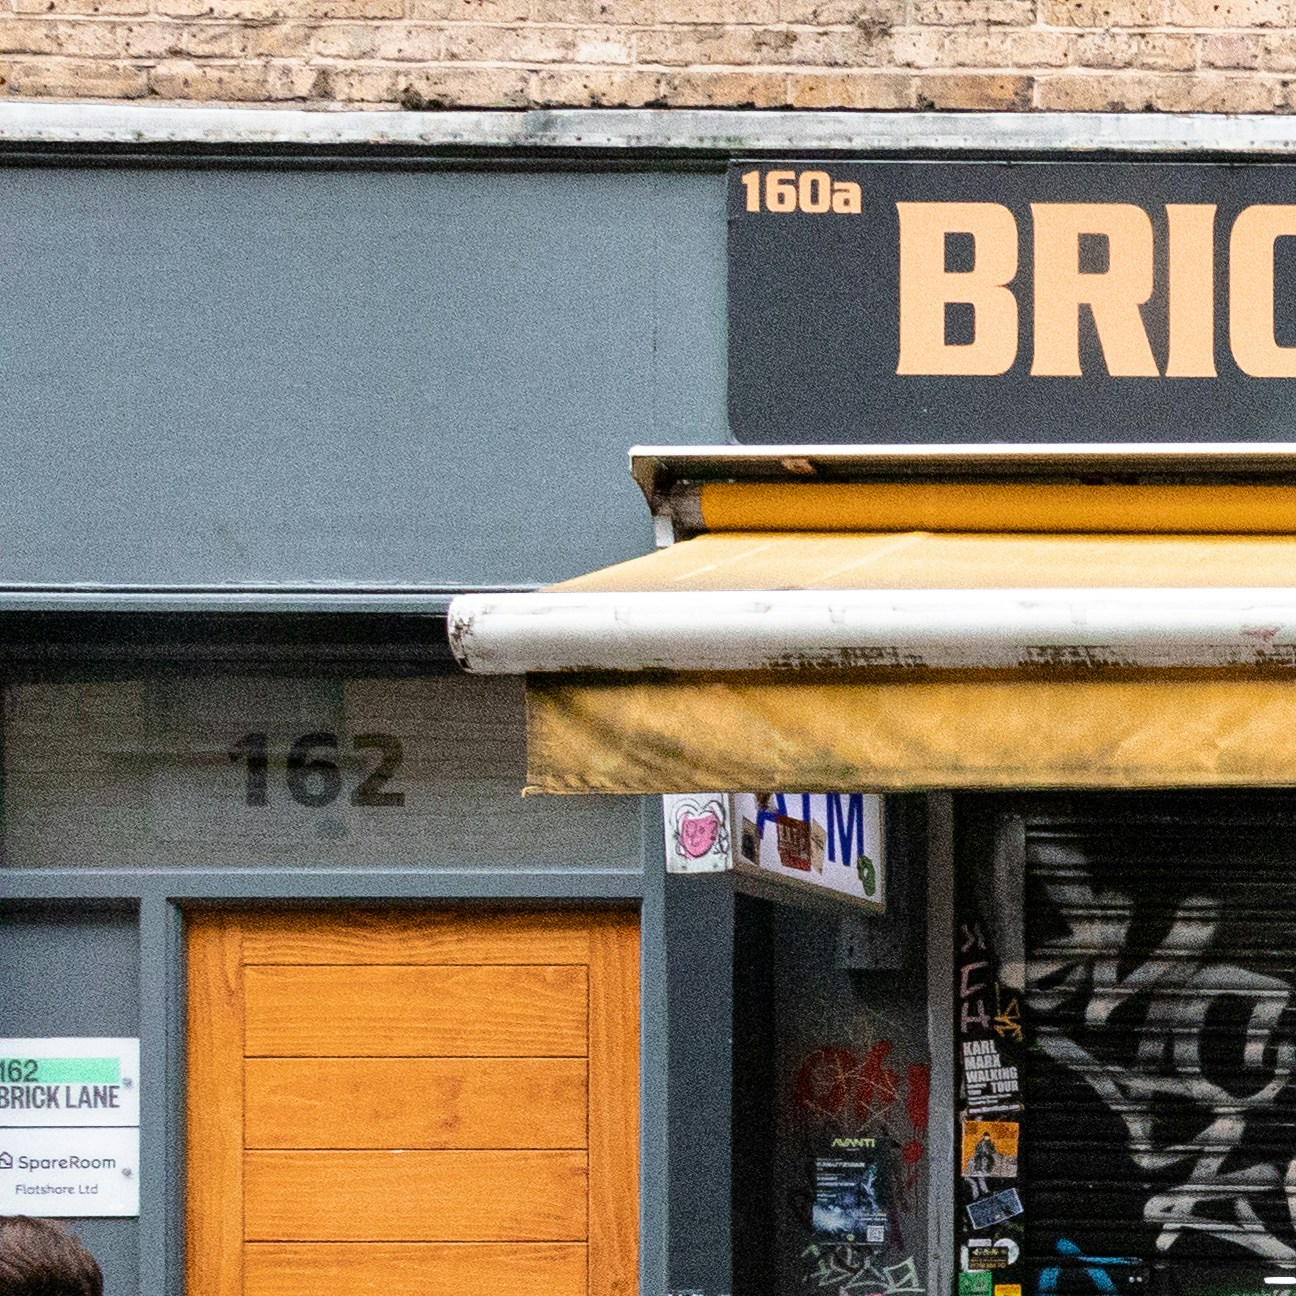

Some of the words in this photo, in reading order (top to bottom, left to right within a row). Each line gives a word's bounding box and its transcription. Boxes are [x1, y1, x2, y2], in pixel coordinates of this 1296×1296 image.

[741, 170, 862, 214] 160a
[229, 732, 406, 808] 162
[966, 1066, 1019, 1084] WALKING
[990, 1080, 1019, 1094] TOUR
[0, 1085, 60, 1109] BRICK
[66, 1085, 120, 1109] LANE
[18, 1155, 116, 1172] SpareRoom
[15, 1184, 75, 1195] Flatshare
[79, 1184, 98, 1195] Ltd
